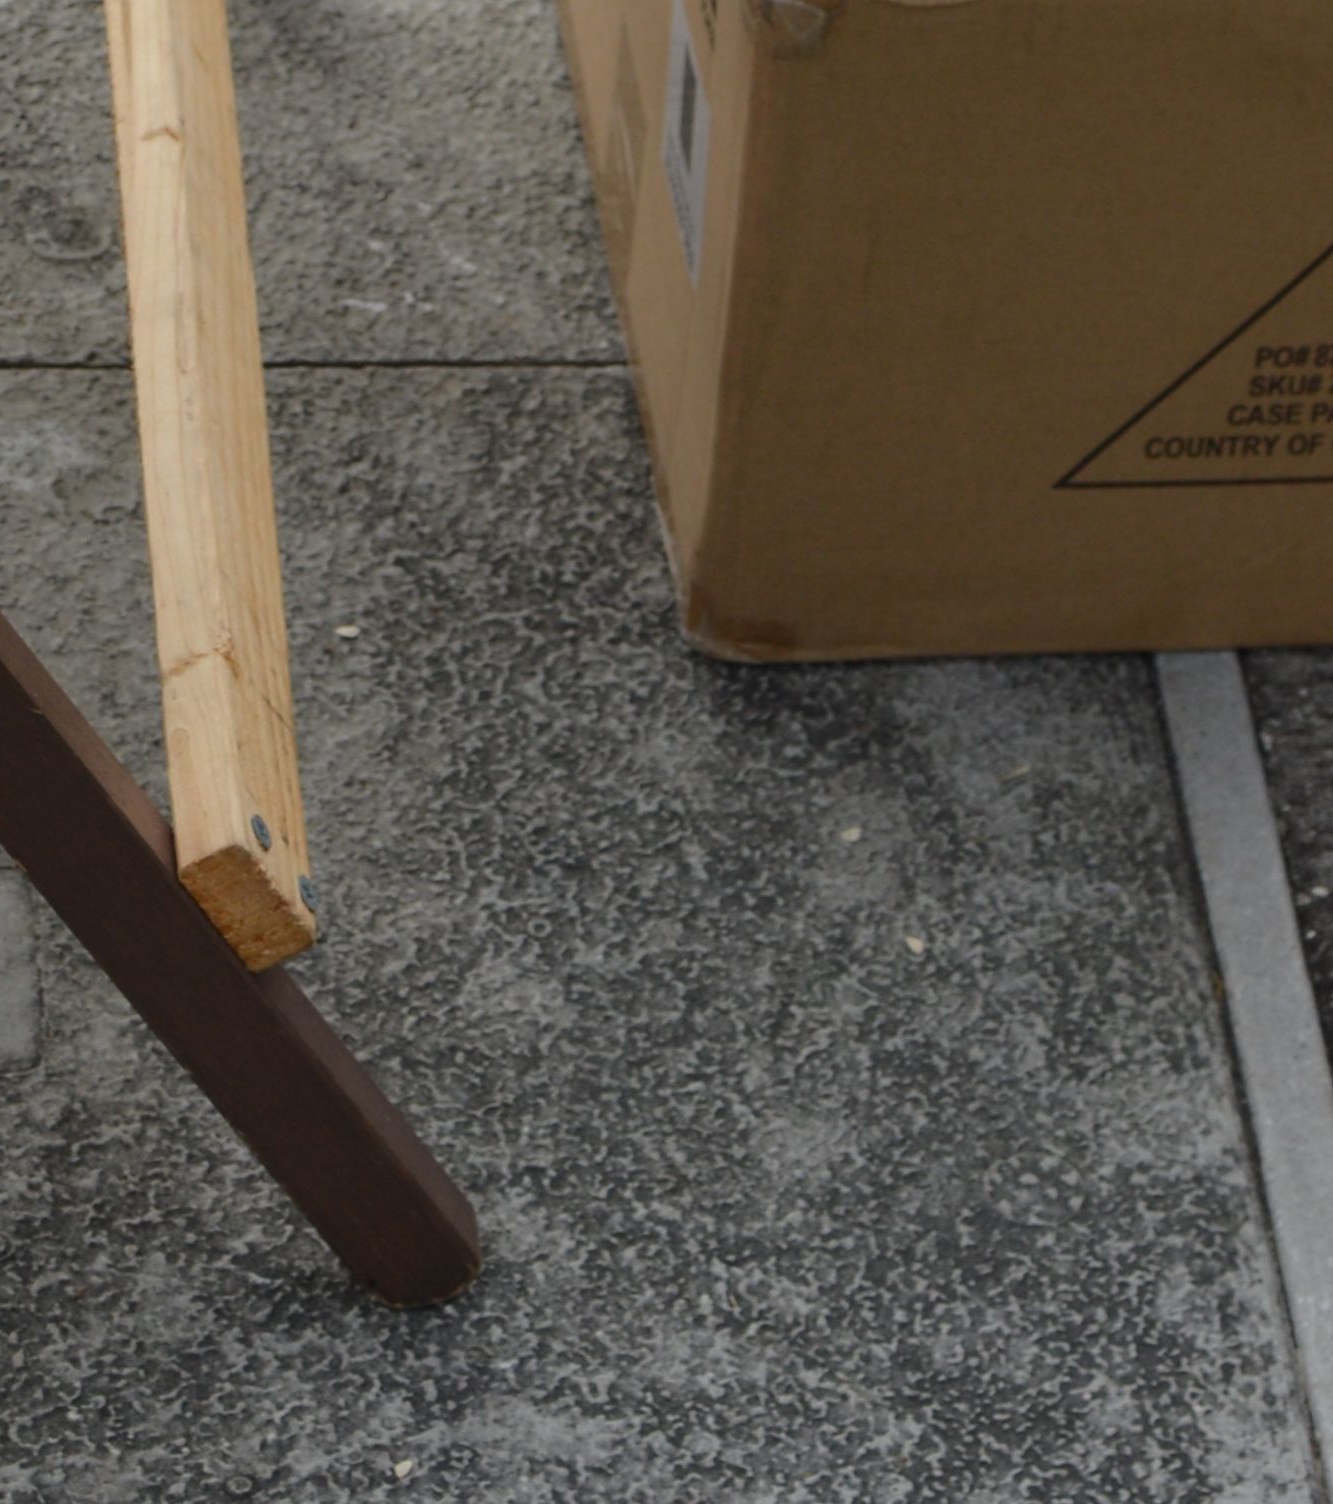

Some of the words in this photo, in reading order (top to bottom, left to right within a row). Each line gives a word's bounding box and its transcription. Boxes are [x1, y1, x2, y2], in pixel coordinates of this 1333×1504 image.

[1227, 403, 1305, 426] CASE
[1144, 435, 1280, 459] COUNTRY
[1286, 433, 1326, 455] OF
